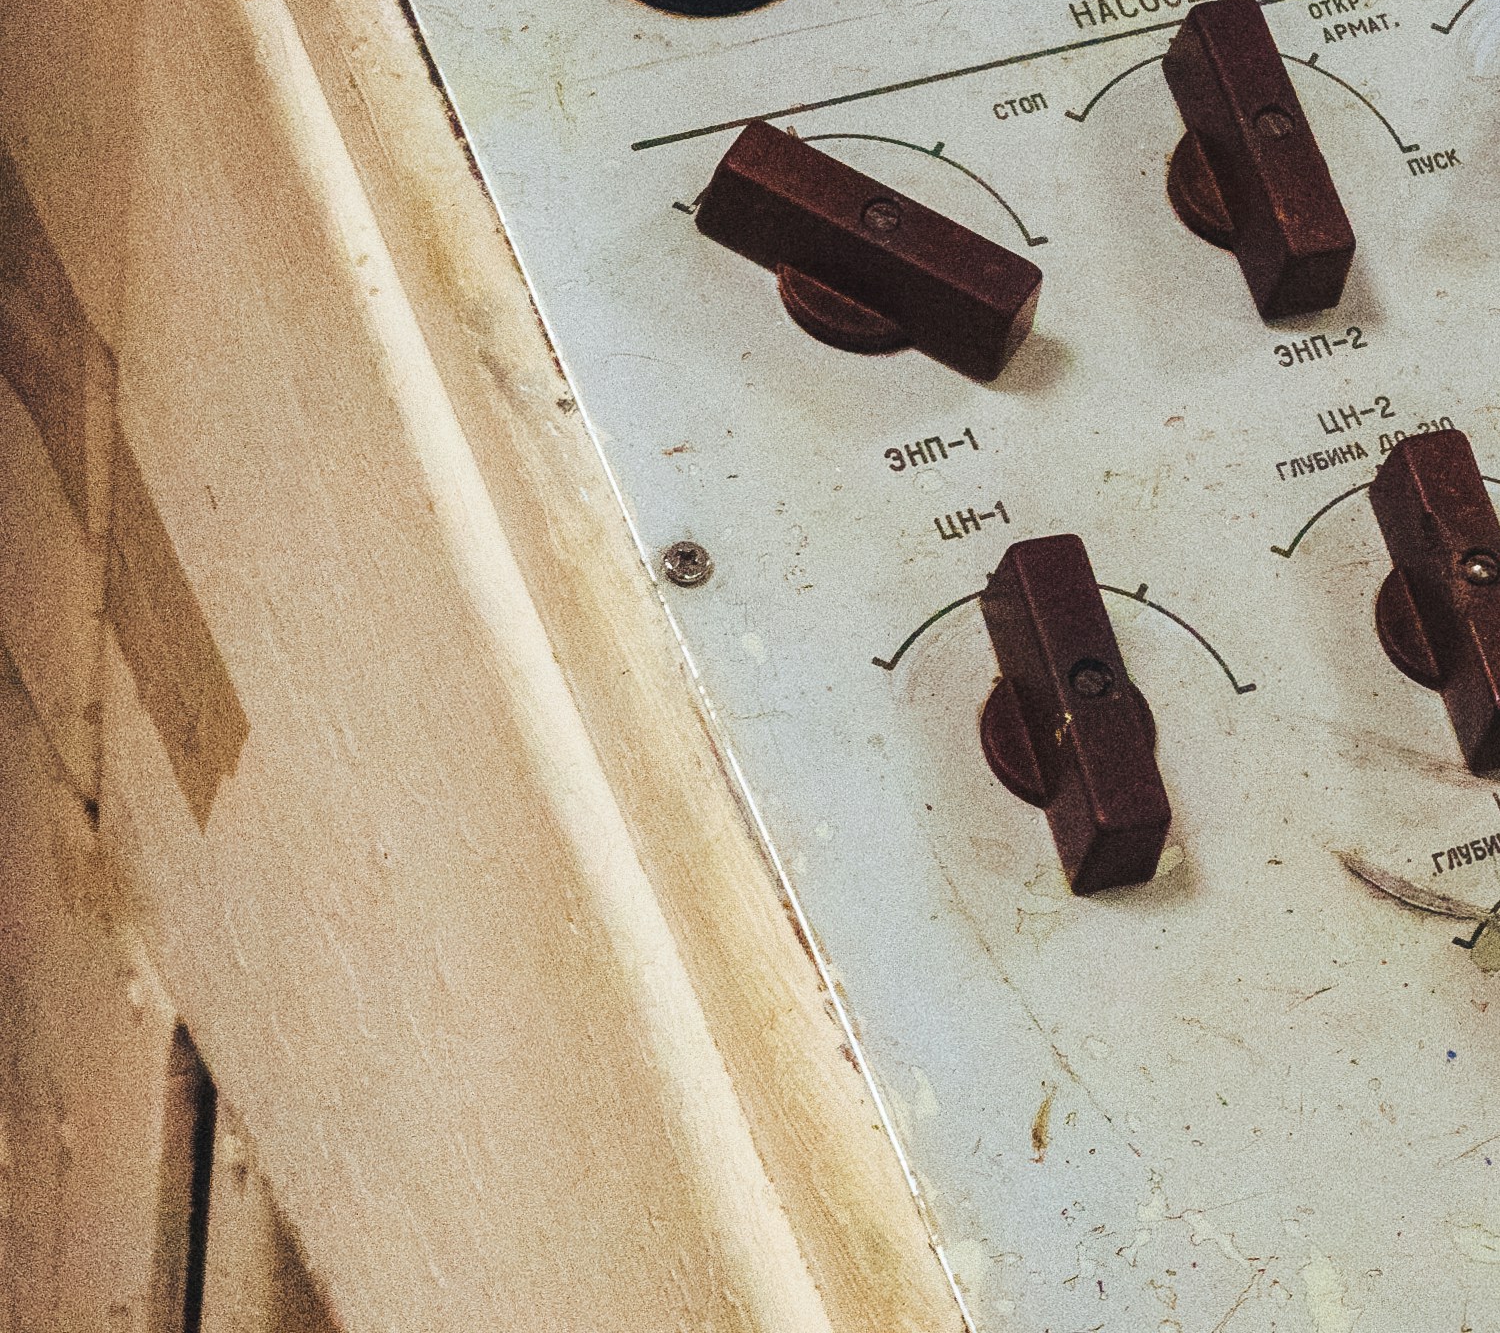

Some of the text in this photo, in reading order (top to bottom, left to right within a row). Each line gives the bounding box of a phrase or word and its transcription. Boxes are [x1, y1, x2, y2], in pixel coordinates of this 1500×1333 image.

[1322, 16, 1401, 45] АРМАТ.
[992, 93, 1048, 121] СТОП
[1407, 149, 1461, 178] ПУСК
[1273, 327, 1369, 368] ЭНП-2
[1317, 397, 1396, 437] ЦН-2
[884, 429, 980, 472] ЭНП-1
[1275, 440, 1369, 482] ГЛУБИНА
[933, 501, 1010, 542] ЦН-1
